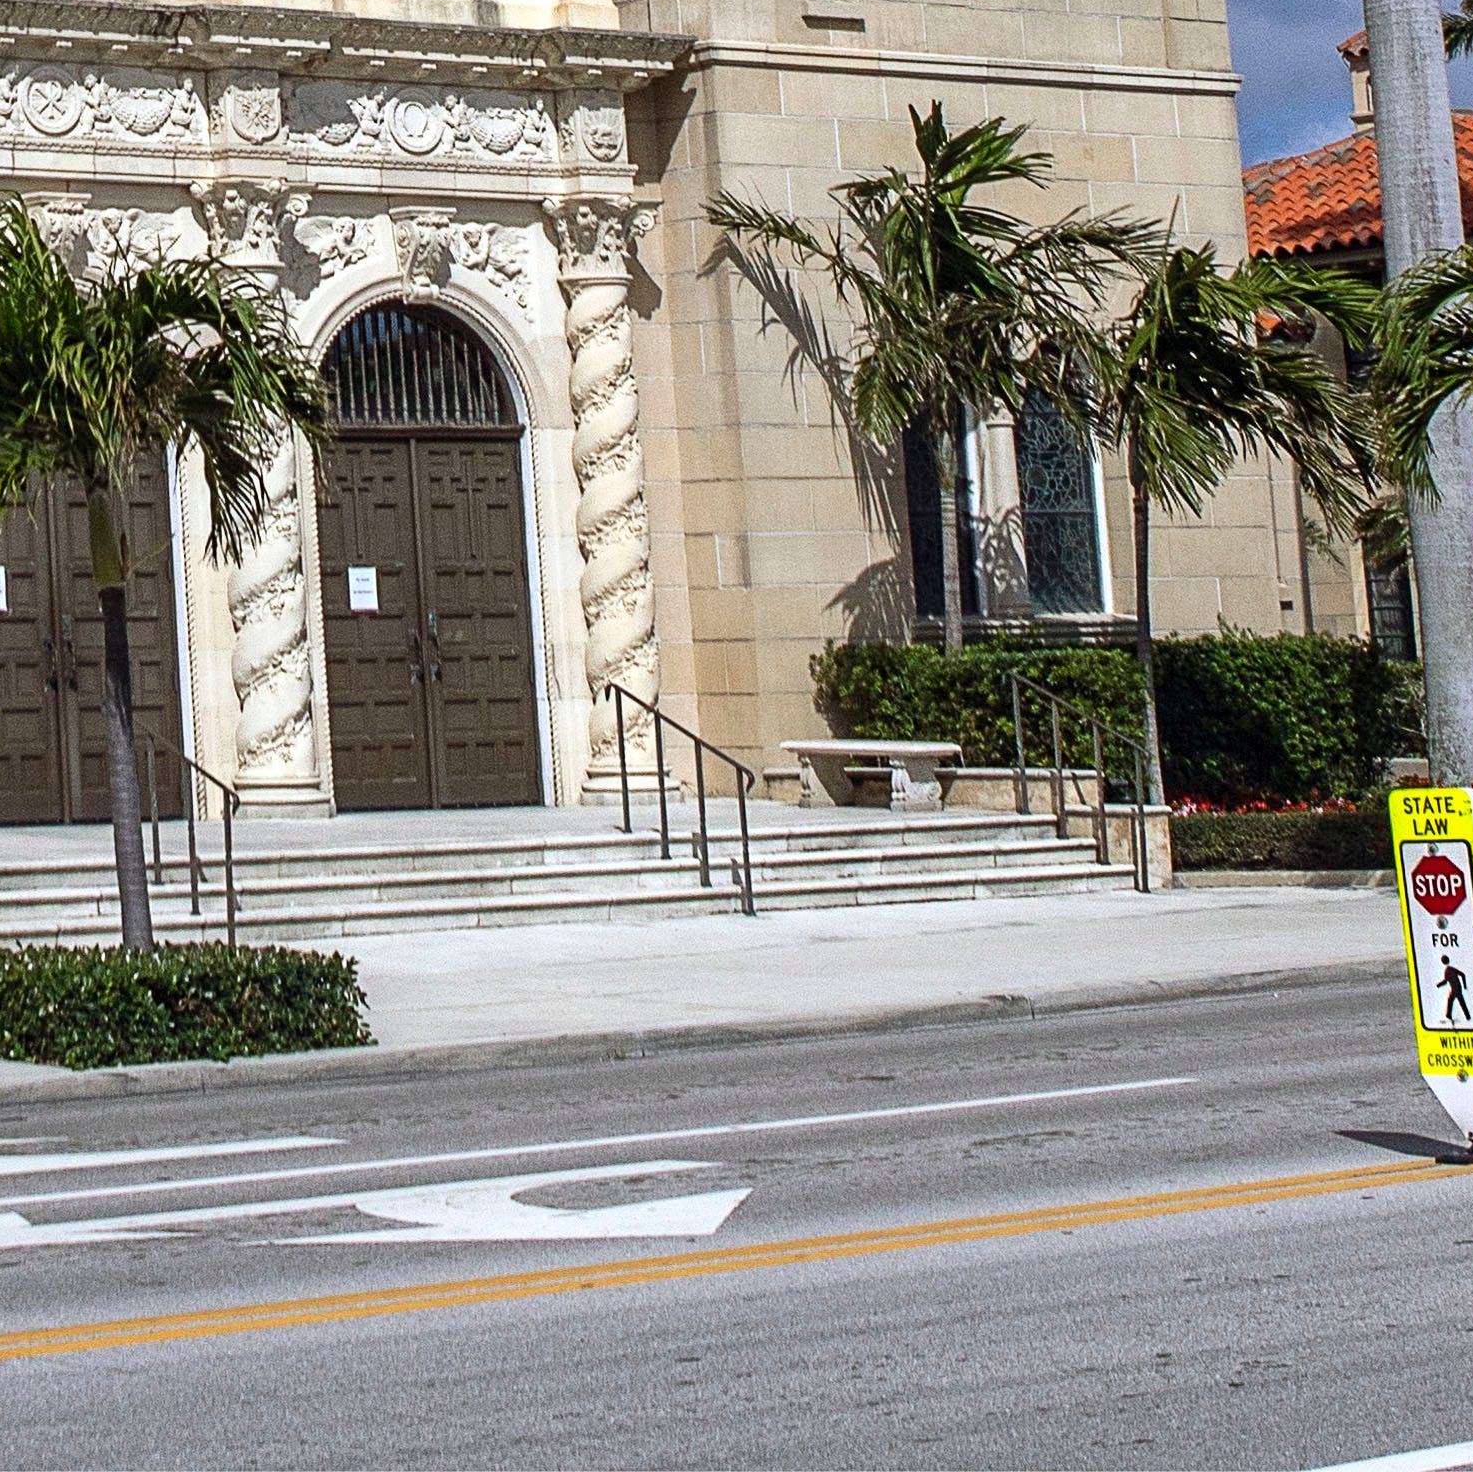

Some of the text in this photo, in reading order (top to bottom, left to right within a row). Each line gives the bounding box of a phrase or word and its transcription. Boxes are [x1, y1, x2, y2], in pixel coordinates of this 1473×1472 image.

[1403, 797, 1455, 815] STATE
[1413, 818, 1449, 836] LAW
[1415, 874, 1462, 897] STOP
[1431, 934, 1459, 947] FOR
